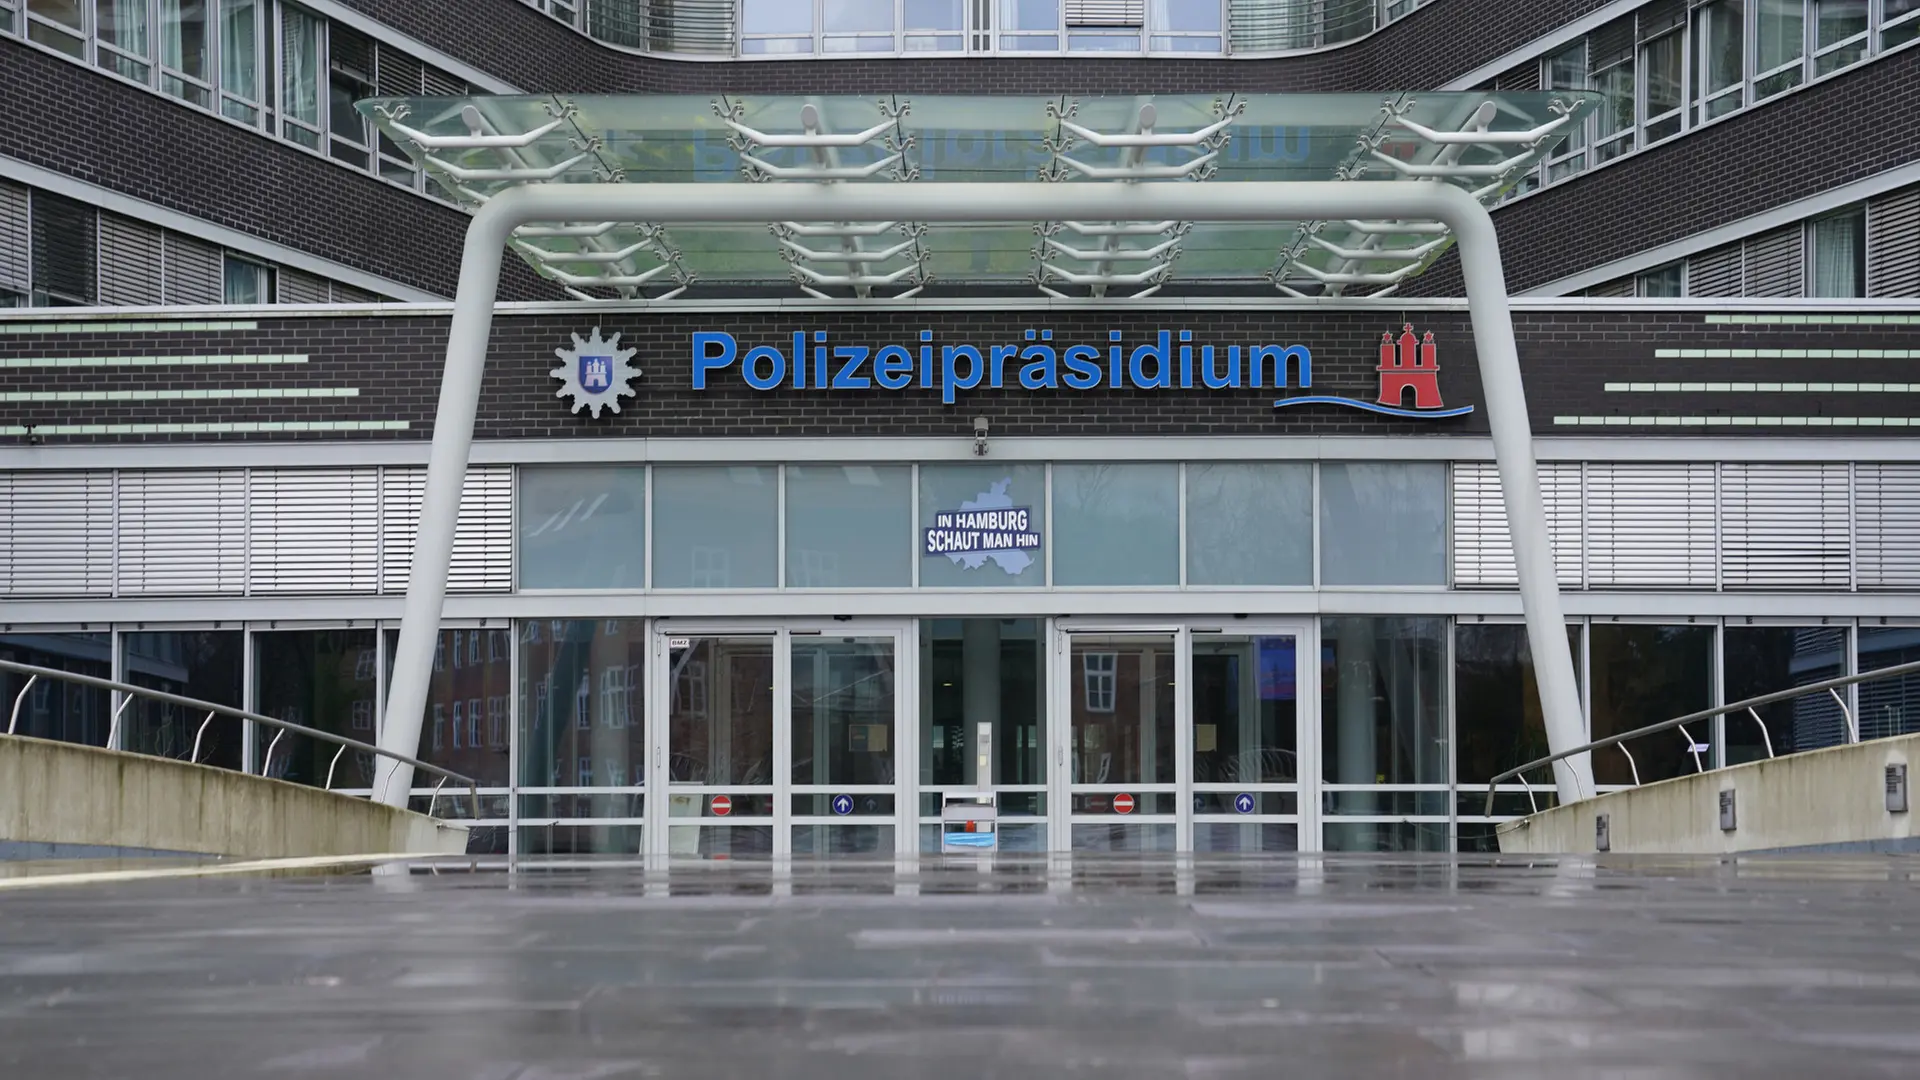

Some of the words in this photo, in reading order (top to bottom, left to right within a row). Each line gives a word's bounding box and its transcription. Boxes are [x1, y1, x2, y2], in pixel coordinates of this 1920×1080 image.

[692, 330, 1312, 403] Polizeipräsidium
[938, 515, 952, 528] IN
[956, 510, 1028, 531] HAMBURG
[927, 529, 980, 552] SCHAUT
[983, 533, 1013, 548] MAN
[1016, 534, 1039, 547] HIN
